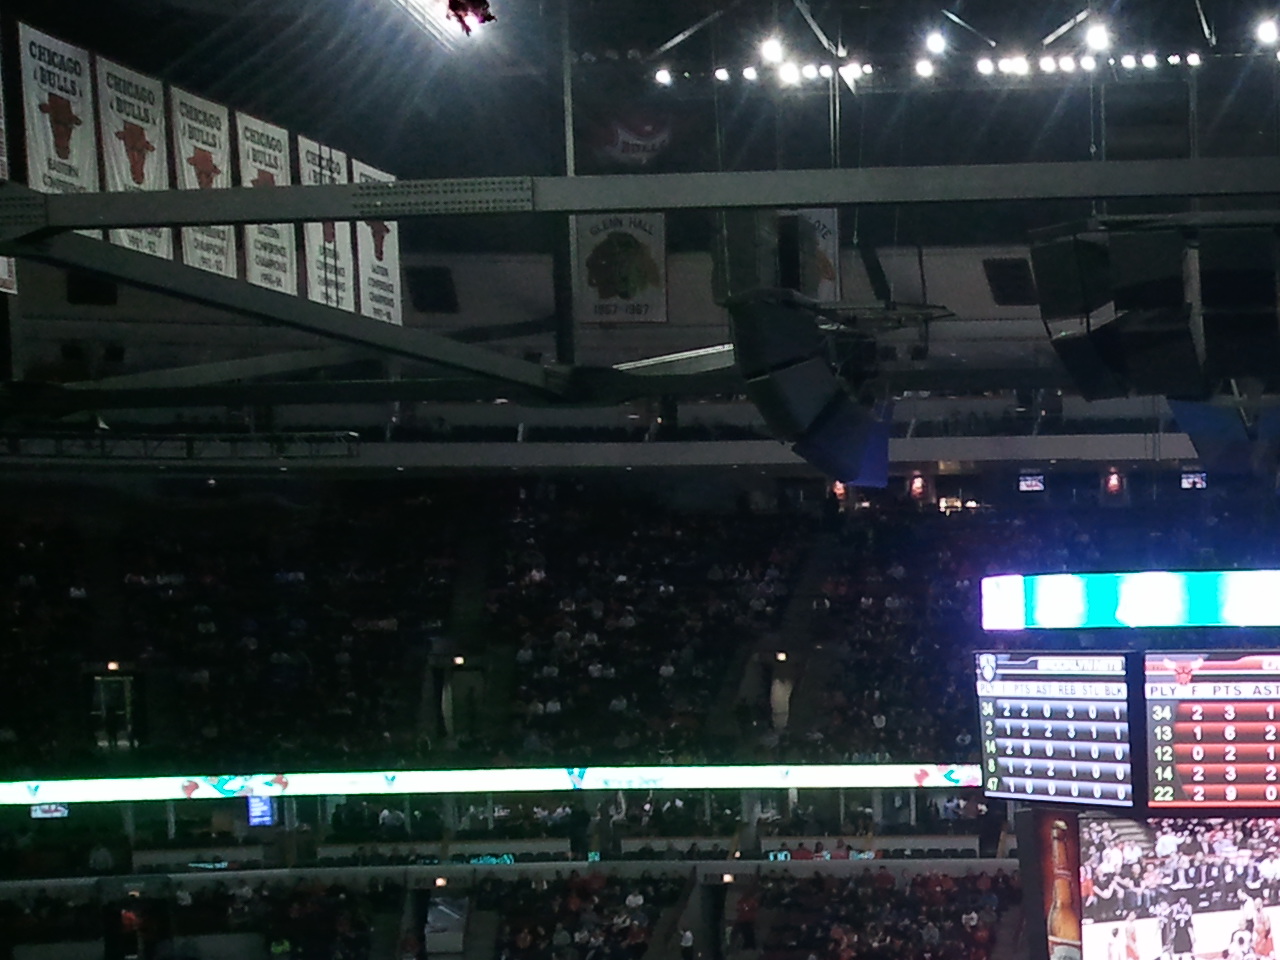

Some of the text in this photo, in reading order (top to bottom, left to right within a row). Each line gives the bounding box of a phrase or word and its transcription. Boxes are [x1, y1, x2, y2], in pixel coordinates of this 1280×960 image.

[29, 40, 82, 77] CHICAGO
[39, 66, 77, 96] BULLS
[105, 72, 155, 106] CHICAGO
[115, 96, 151, 124] BULLS
[244, 127, 283, 153] CHICAGO
[252, 149, 279, 170] BULLS
[1151, 684, 1176, 695] PLY
[1214, 684, 1241, 695] PTS
[1253, 684, 1280, 695] AST
[1152, 706, 1172, 719] 34
[1193, 706, 1203, 719] 2
[1225, 706, 1236, 719] 3
[1154, 726, 1173, 740] 13
[1225, 726, 1236, 740] 6
[1265, 726, 1276, 740] 2
[1154, 746, 1173, 760] 12
[1193, 746, 1203, 760] 0
[1225, 746, 1236, 760] 2
[1154, 766, 1173, 780] 14
[1193, 766, 1203, 780] 2
[1225, 766, 1236, 780] 3
[1265, 766, 1276, 780] 2
[1154, 786, 1173, 801] 22
[1193, 786, 1203, 801] 2
[1225, 786, 1236, 801] 9
[1265, 786, 1276, 801] 0
